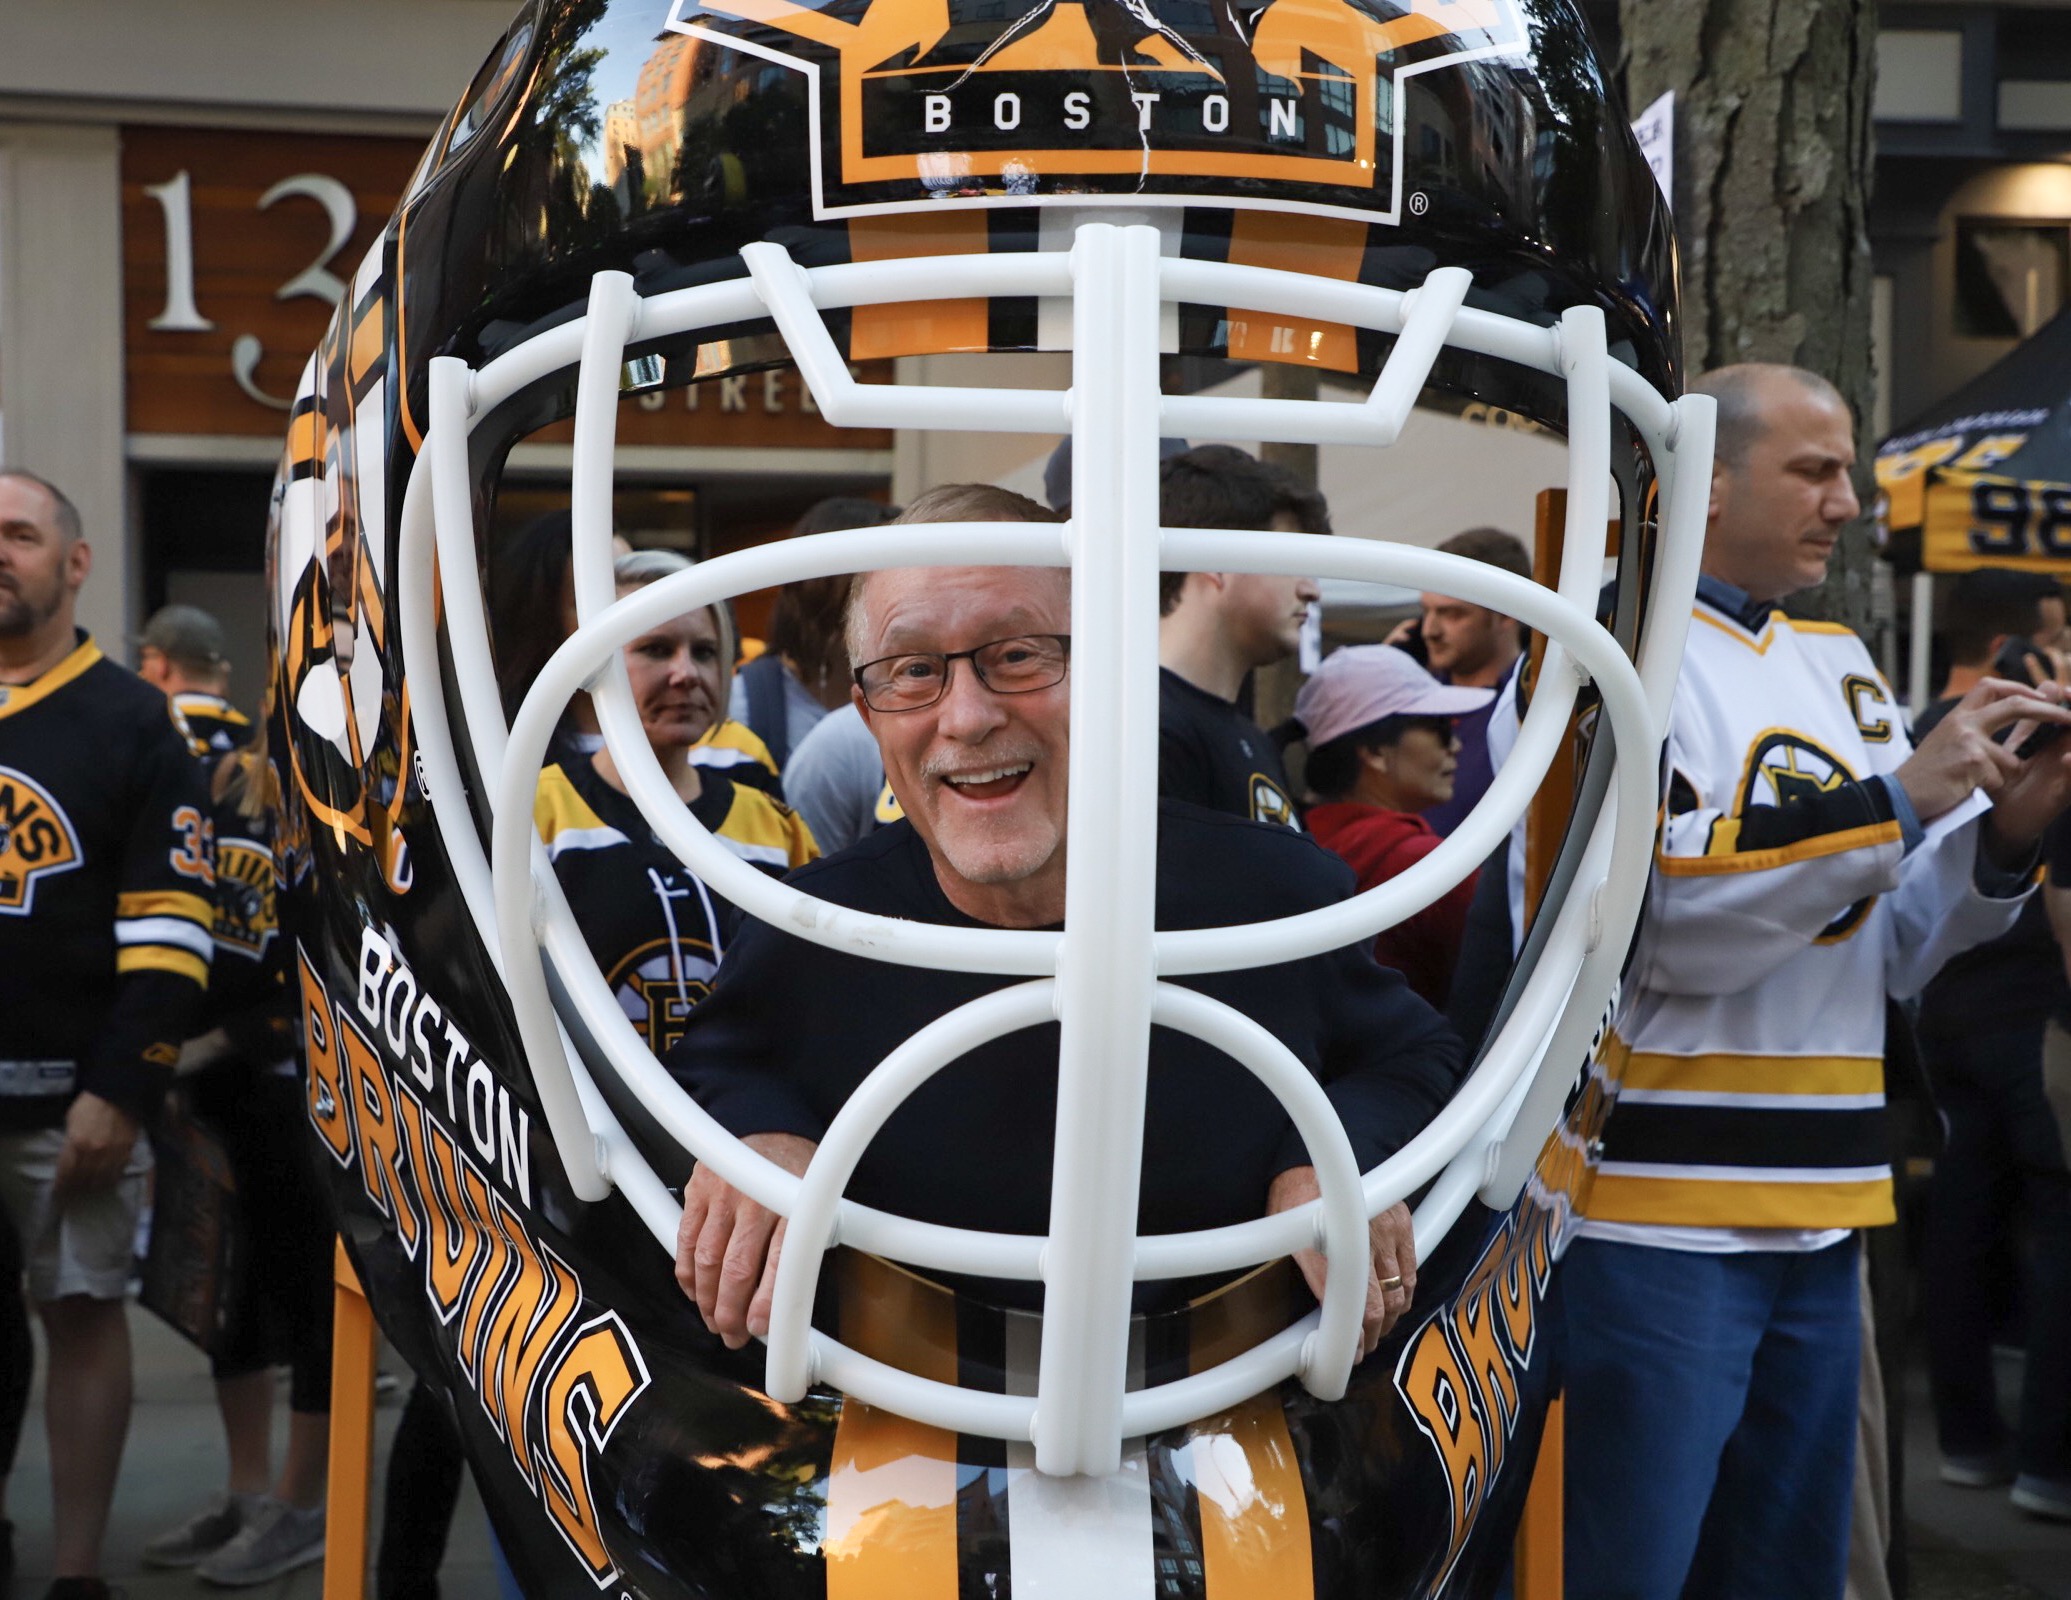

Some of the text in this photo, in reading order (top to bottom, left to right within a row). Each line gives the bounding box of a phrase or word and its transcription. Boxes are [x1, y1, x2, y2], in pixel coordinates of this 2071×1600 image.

[925, 92, 1297, 137] BOSTON
[1840, 673, 1893, 743] C
[358, 925, 531, 1211] BOSTON
[297, 936, 652, 1591] BRUINS
